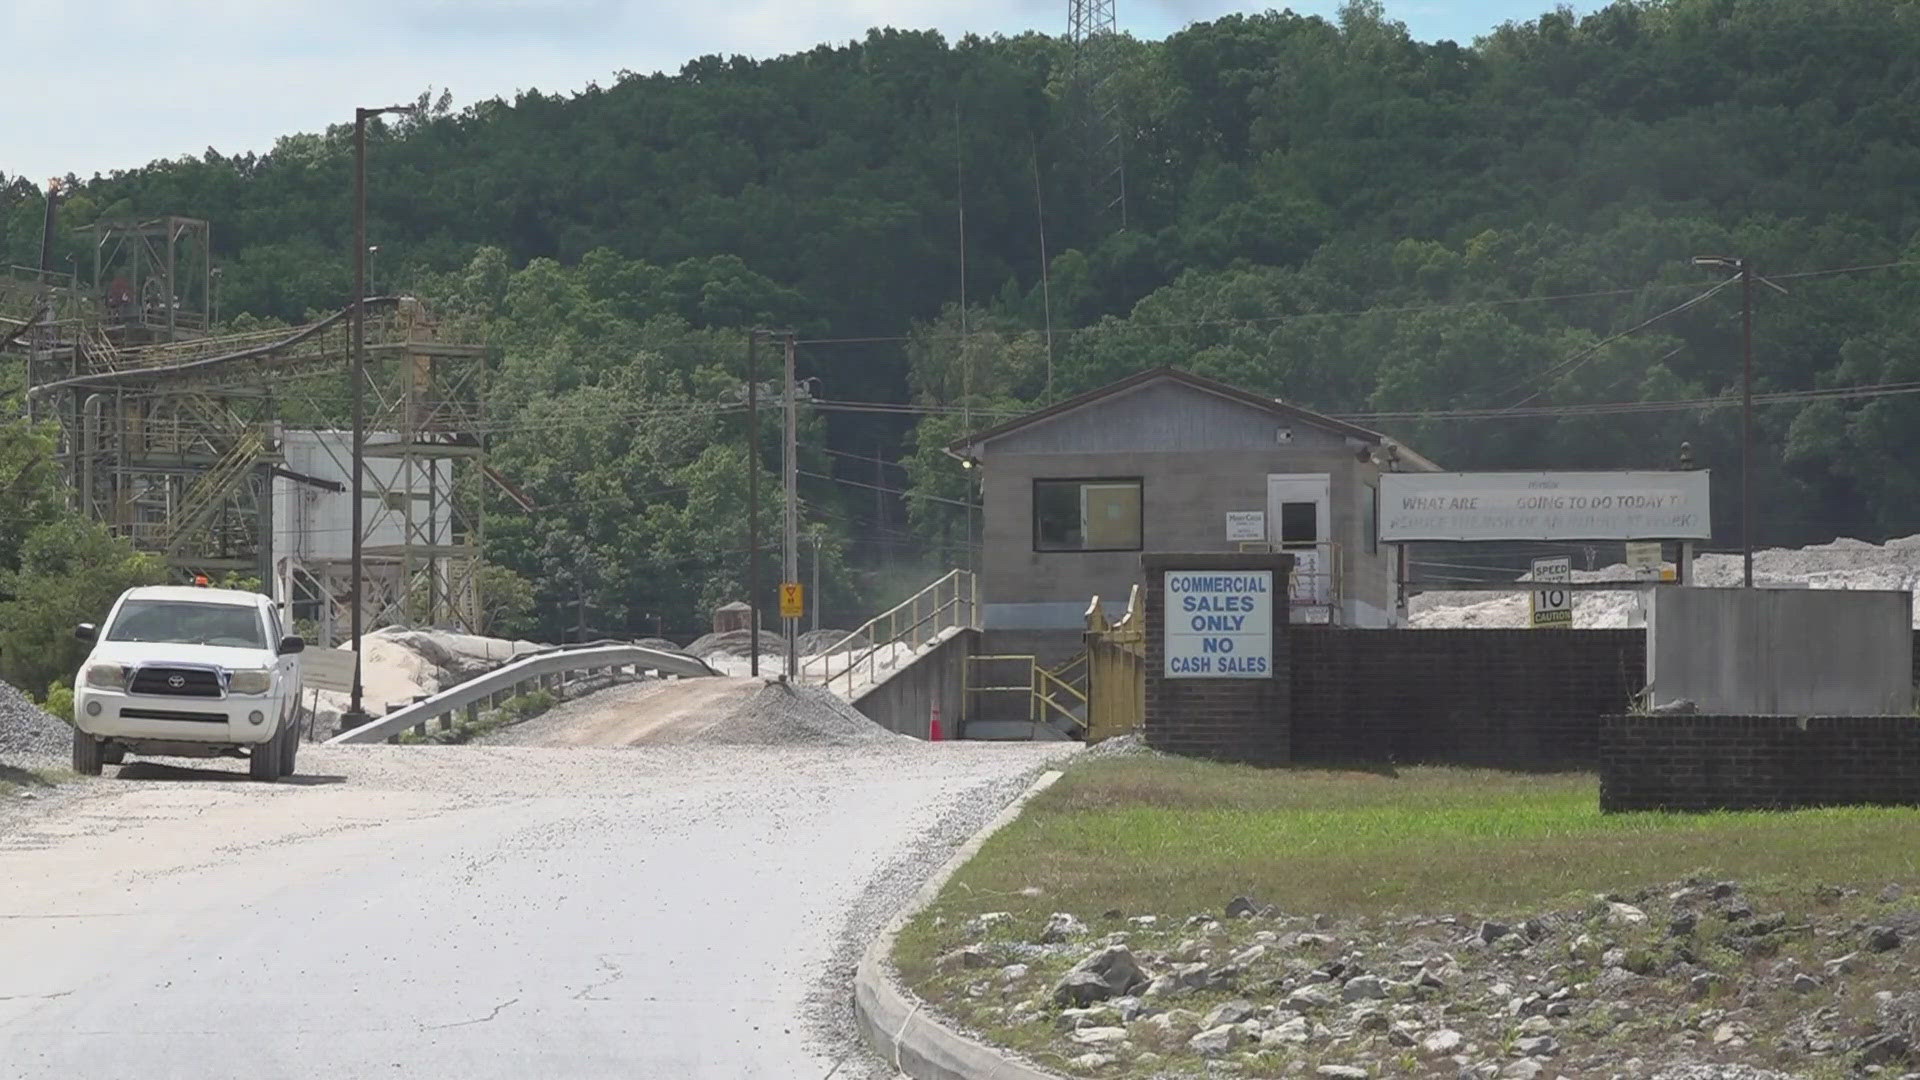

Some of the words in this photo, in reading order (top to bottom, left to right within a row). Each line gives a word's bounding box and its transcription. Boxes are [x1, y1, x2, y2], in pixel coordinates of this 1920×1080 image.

[1402, 496, 1446, 511] WHAT
[1449, 496, 1479, 510] ARE
[1516, 496, 1564, 510] GOING
[1570, 496, 1588, 509] TO
[1591, 496, 1613, 509] DO
[1617, 495, 1665, 509] TODAY
[1536, 564, 1568, 576] SPEED
[1170, 576, 1267, 593] COMMERCIAL
[1182, 595, 1255, 612] SALES
[1540, 590, 1564, 609] 10
[1191, 615, 1246, 632] ONLY
[1536, 611, 1571, 622] CAUTION
[1202, 637, 1234, 654] NO
[1170, 656, 1211, 673] CASH
[1217, 656, 1267, 673] SALES
